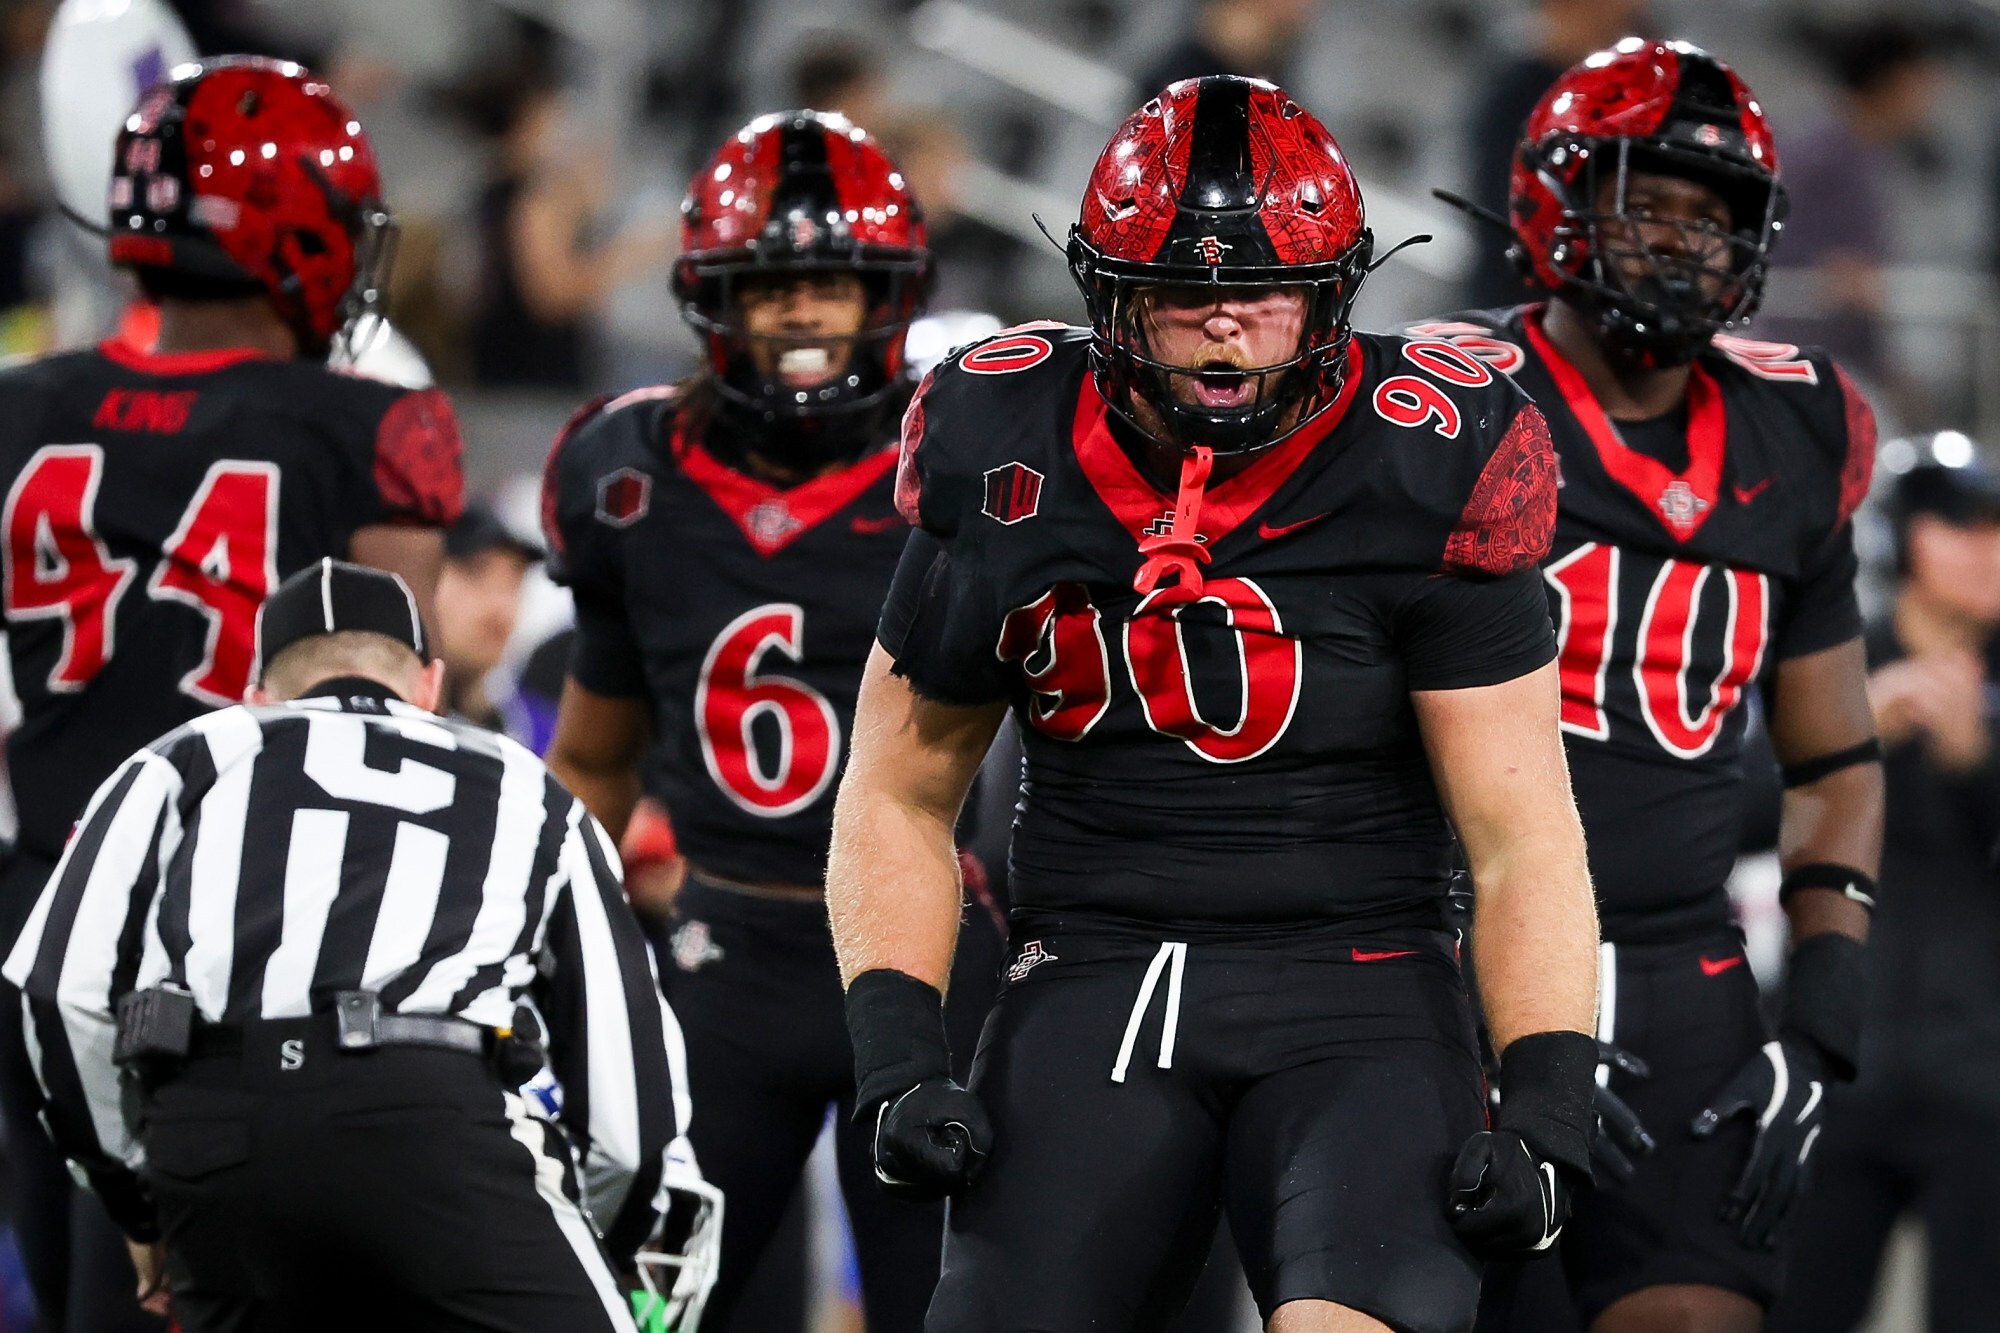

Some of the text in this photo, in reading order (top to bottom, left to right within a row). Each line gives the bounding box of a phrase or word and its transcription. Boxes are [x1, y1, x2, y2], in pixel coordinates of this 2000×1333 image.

[1372, 340, 1494, 440] 90
[3, 443, 280, 706] 44
[996, 577, 1302, 764] 90
[1543, 542, 1769, 760] 10
[694, 603, 841, 818] 6
[281, 1039, 304, 1071] S
